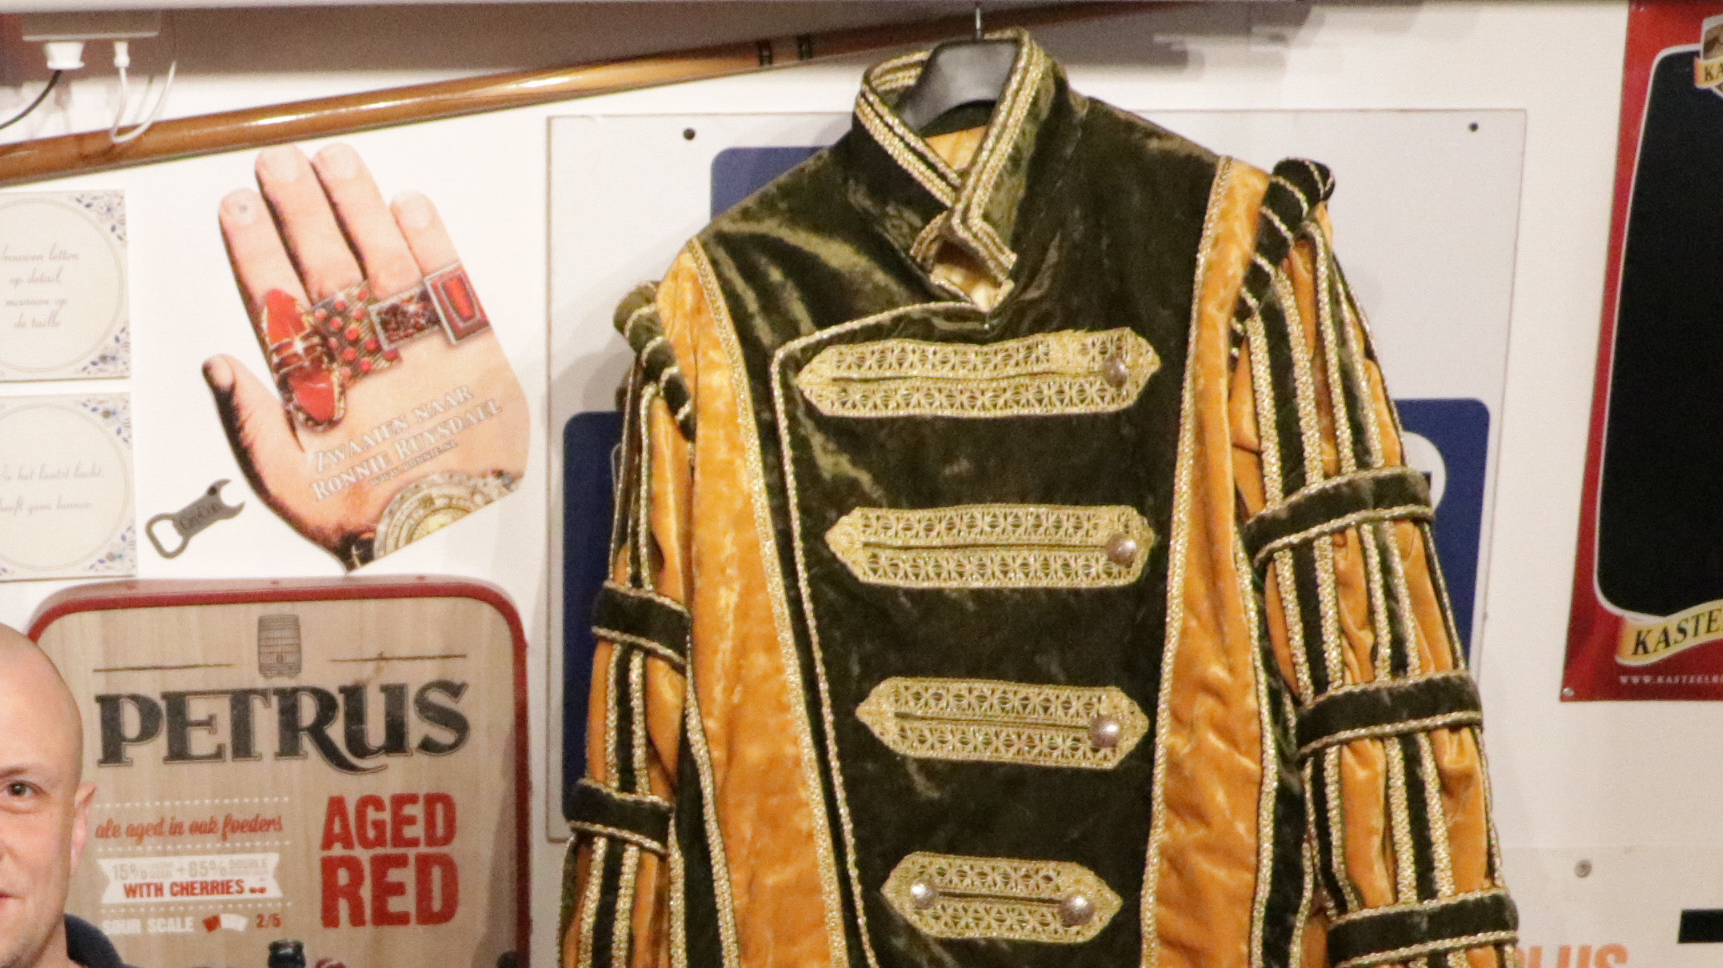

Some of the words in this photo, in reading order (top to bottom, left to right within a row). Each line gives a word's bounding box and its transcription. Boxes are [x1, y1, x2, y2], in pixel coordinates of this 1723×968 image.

[314, 414, 409, 473] ZWAAIEN
[412, 385, 474, 421] NAAR
[310, 452, 394, 502] RONNIE
[94, 678, 471, 775] PETRUS
[96, 818, 120, 839] ale
[127, 818, 165, 845] aged
[168, 816, 185, 836] in
[189, 816, 217, 835] oak
[221, 813, 284, 842] foeders
[320, 792, 457, 851] AGED
[123, 882, 164, 899] WITH
[170, 879, 245, 897] CHERRIES
[320, 852, 459, 928] RED
[147, 916, 195, 933] SCALE
[255, 913, 282, 928] 2/5
